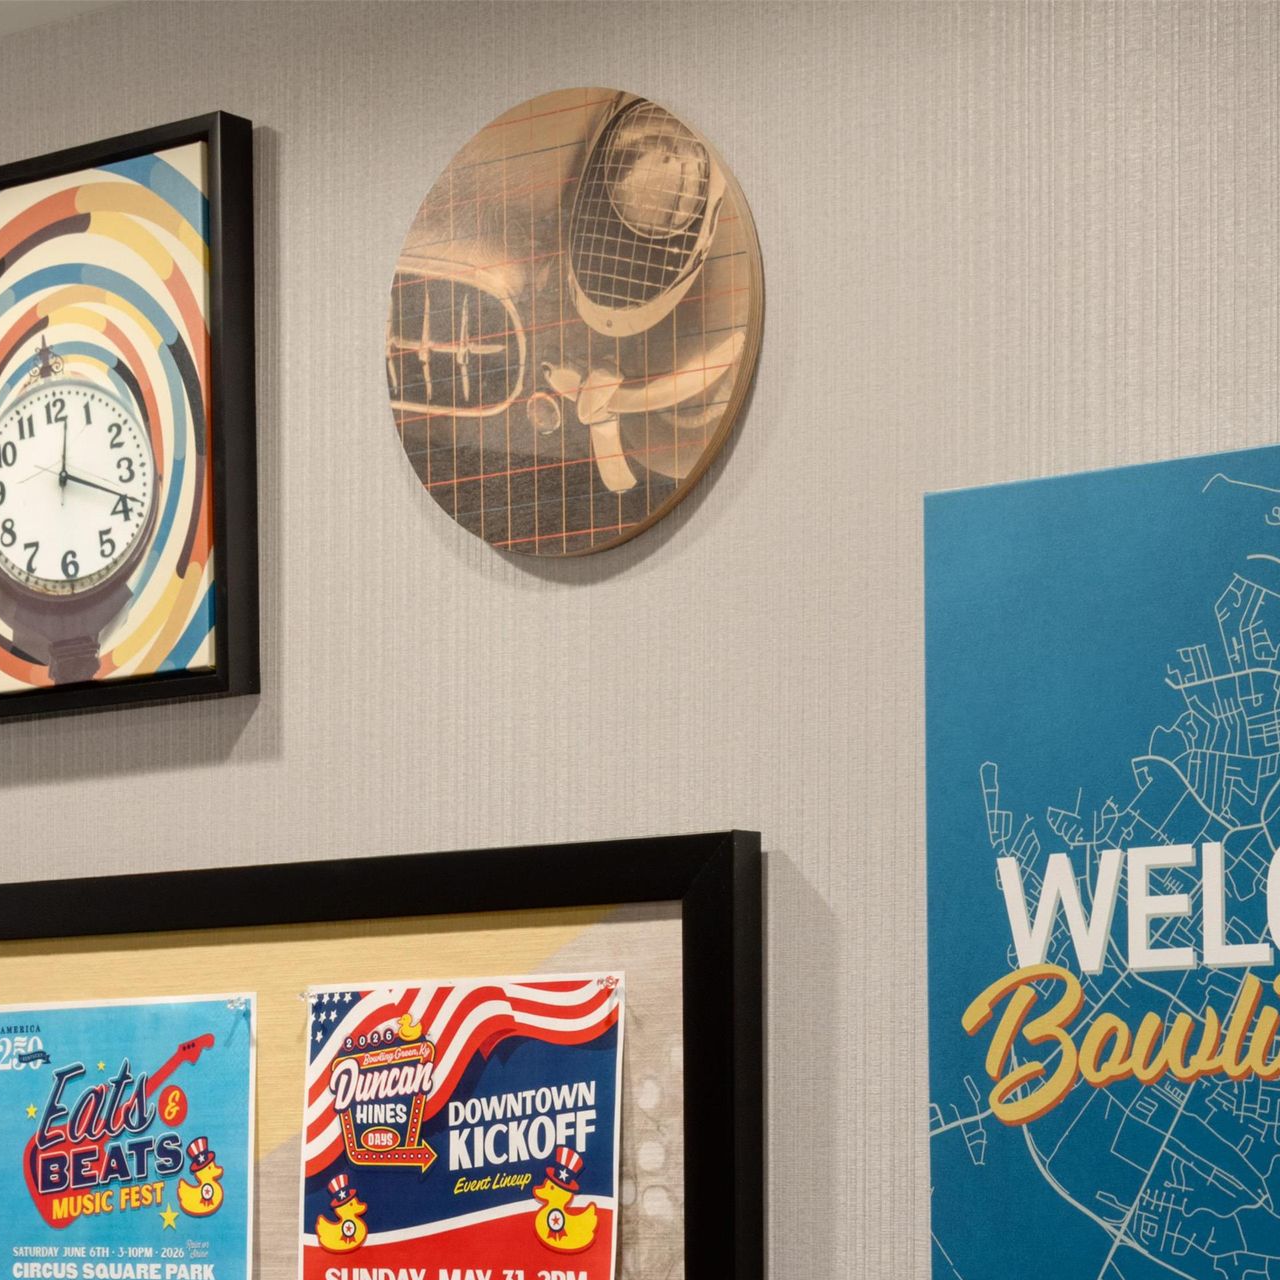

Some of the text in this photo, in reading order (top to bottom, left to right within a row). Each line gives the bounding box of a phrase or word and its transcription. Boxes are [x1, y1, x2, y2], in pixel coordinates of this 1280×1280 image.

[44, 399, 68, 425] 12
[83, 402, 92, 425] 1
[18, 415, 35, 440] 11
[108, 423, 125, 449] 2
[117, 457, 135, 483] 3
[111, 494, 133, 521] 4
[1, 519, 16, 547] 8
[99, 528, 116, 558] 5
[24, 541, 39, 573] 7
[61, 550, 79, 579] 6
[0, 1025, 41, 1034] AMERICA
[344, 1031, 394, 1050] 2026
[363, 1053, 394, 1065] Bowling
[420, 1044, 430, 1058] Ky
[330, 1059, 435, 1110] Duncan
[36, 1057, 180, 1149] Eats &
[356, 1103, 407, 1124] HINES
[449, 1081, 595, 1126] DOWNTOWN
[368, 1133, 393, 1145] DAYS
[449, 1109, 596, 1171] KICKOFF
[38, 1132, 184, 1194] BEATS
[454, 1172, 532, 1195] Event Lineup
[52, 1183, 164, 1220] MUSIC FEST
[12, 1247, 58, 1257] SATURDAY
[63, 1248, 86, 1257] JUNE
[89, 1248, 109, 1257] 6TH
[161, 1248, 184, 1258] 2026
[12, 1263, 215, 1280] CIRCUS SQUARE PARK
